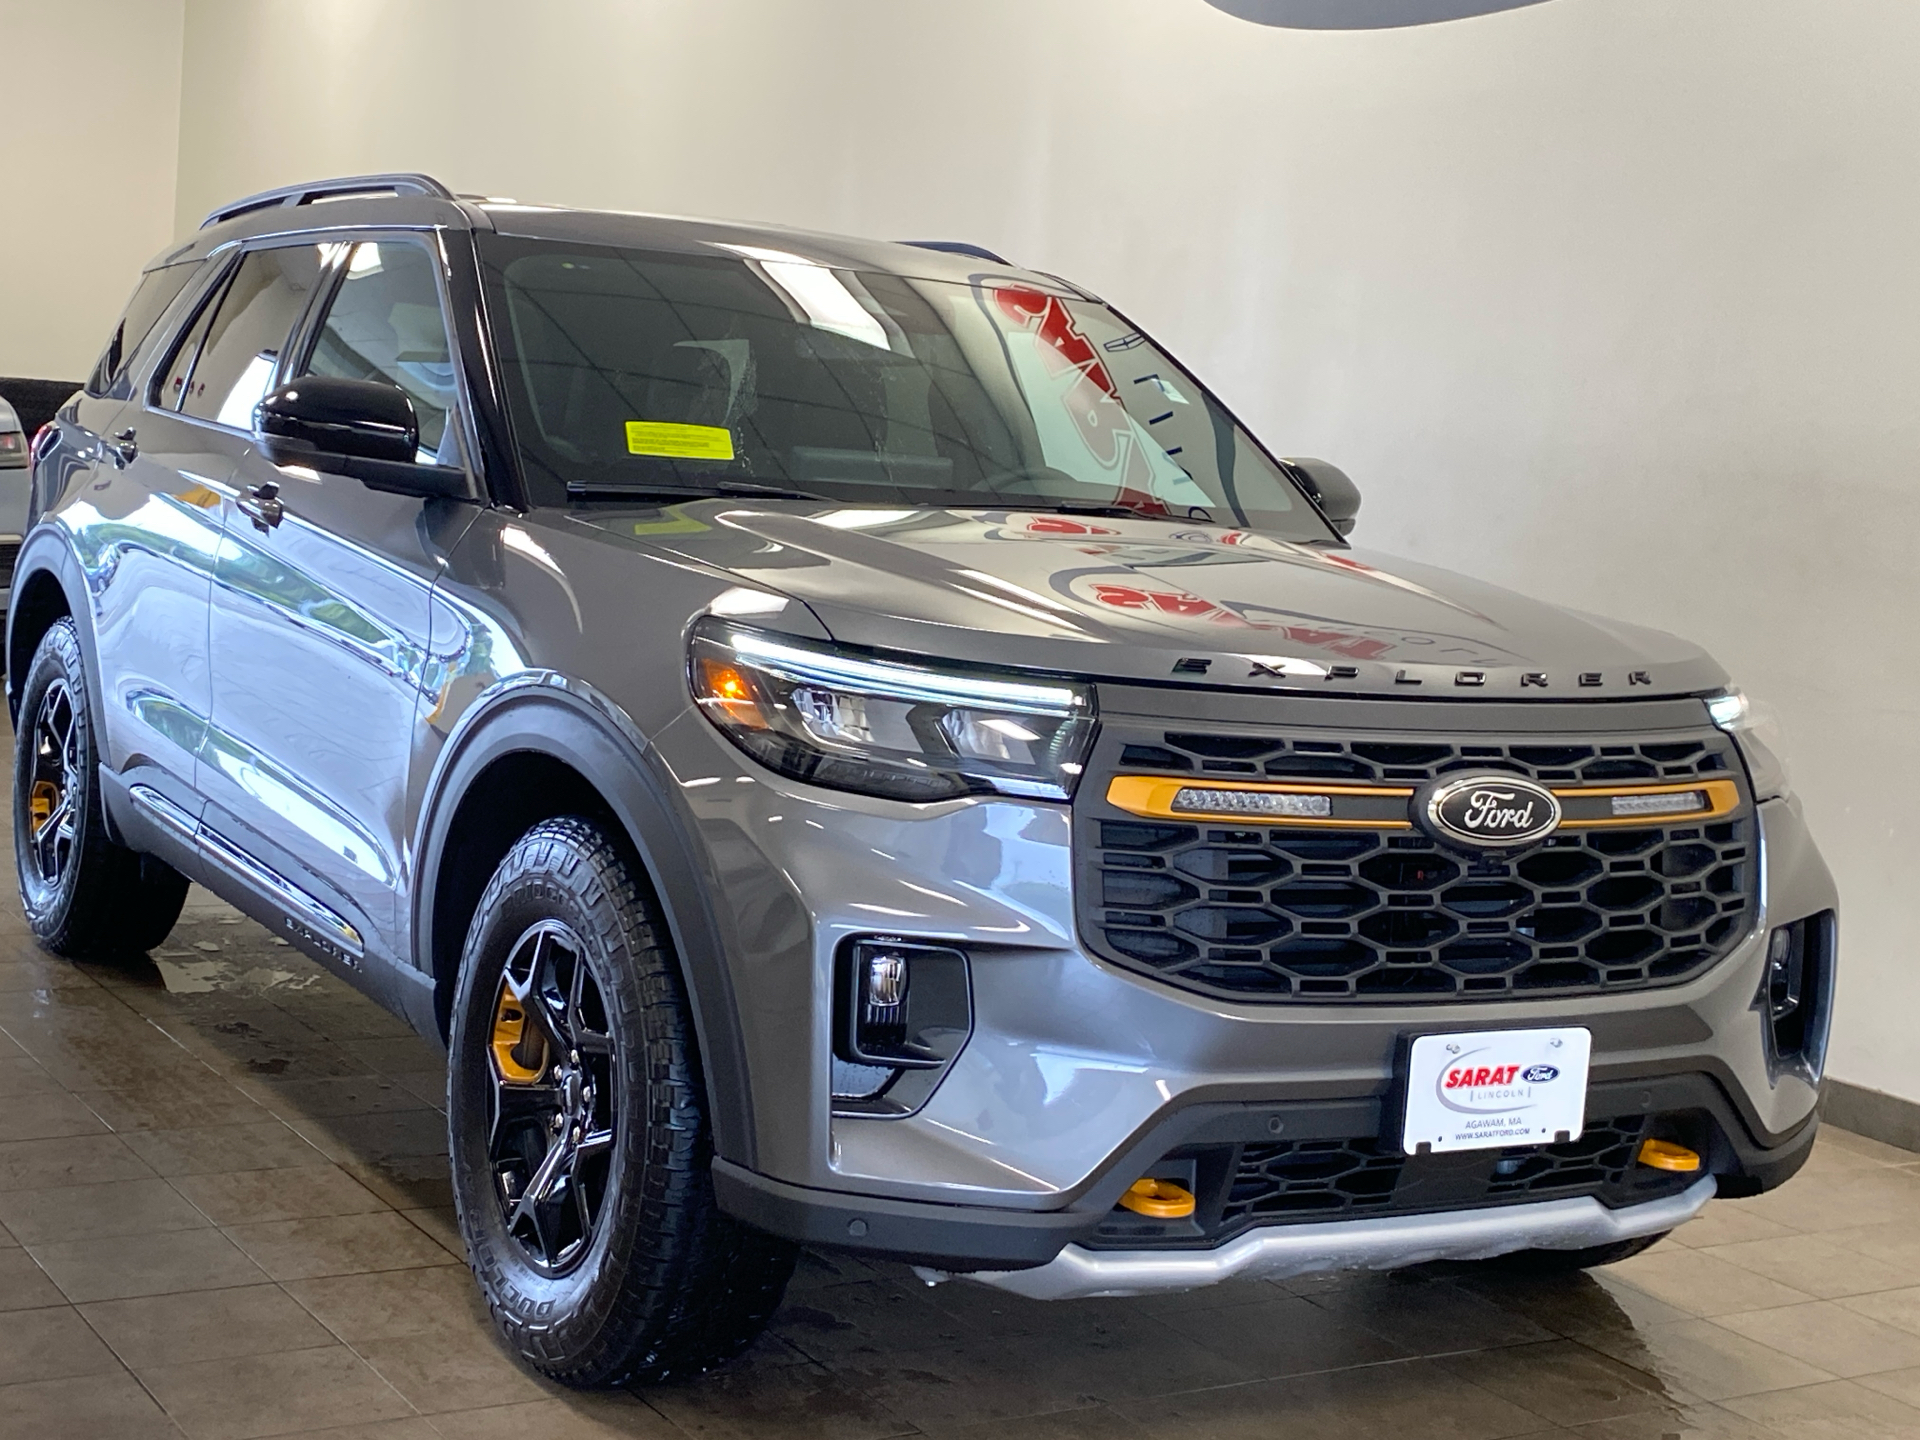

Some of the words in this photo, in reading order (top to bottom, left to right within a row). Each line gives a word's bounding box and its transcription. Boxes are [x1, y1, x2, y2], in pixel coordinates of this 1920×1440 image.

[1172, 657, 1652, 687] EXPLORER
[1464, 790, 1533, 829] Ford
[1445, 1064, 1521, 1089] SARAT
[1477, 1089, 1524, 1100] LINCOLN
[1465, 1118, 1505, 1130] AGAWAM,
[1508, 1117, 1522, 1126] MA
[1455, 1128, 1531, 1141] WWW.SARATFORD.COM
